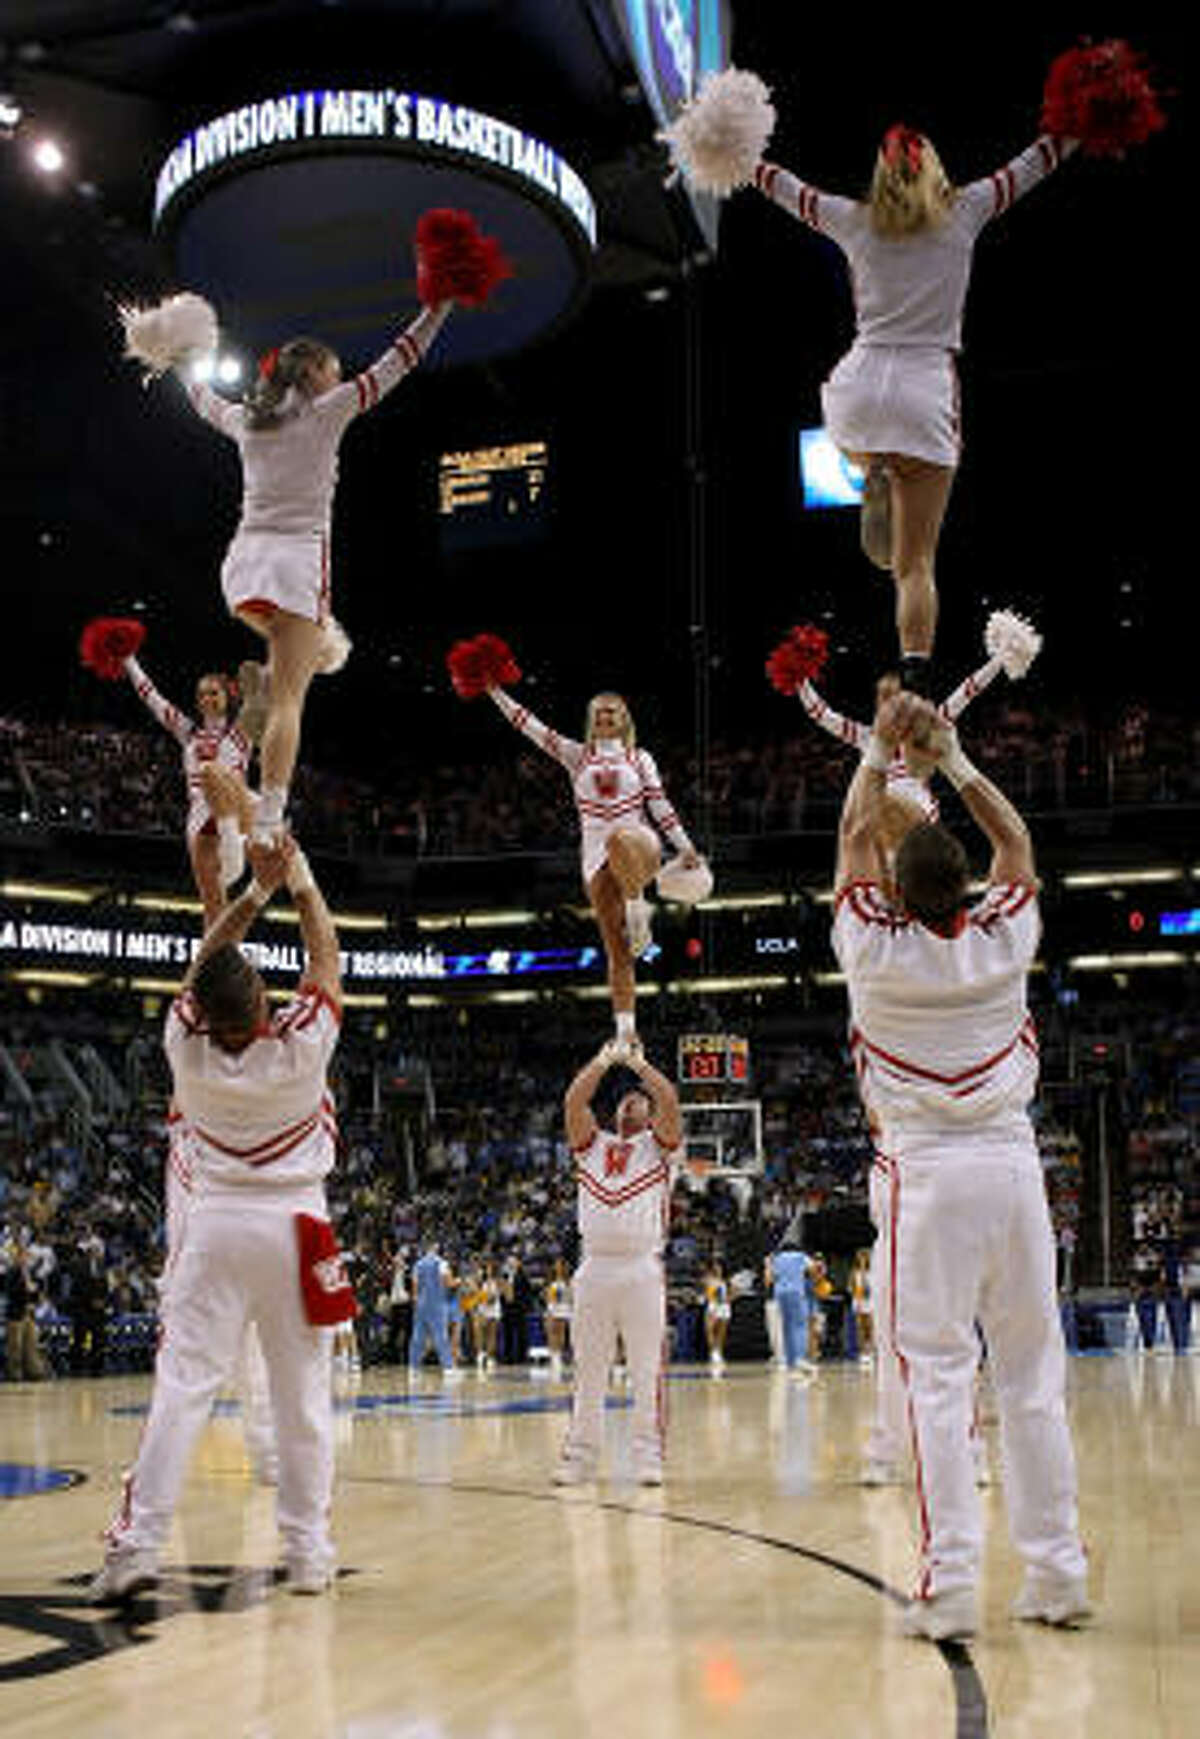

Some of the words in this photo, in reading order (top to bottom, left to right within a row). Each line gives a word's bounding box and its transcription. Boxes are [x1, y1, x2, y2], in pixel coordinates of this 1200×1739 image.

[195, 94, 297, 173] DIVISION
[304, 93, 314, 137] I
[320, 88, 411, 137] MEN'S
[416, 96, 558, 196] BASKETBALL
[21, 923, 109, 957] DIVISION
[126, 931, 188, 962] MEN'S
[755, 937, 799, 953] UCLA
